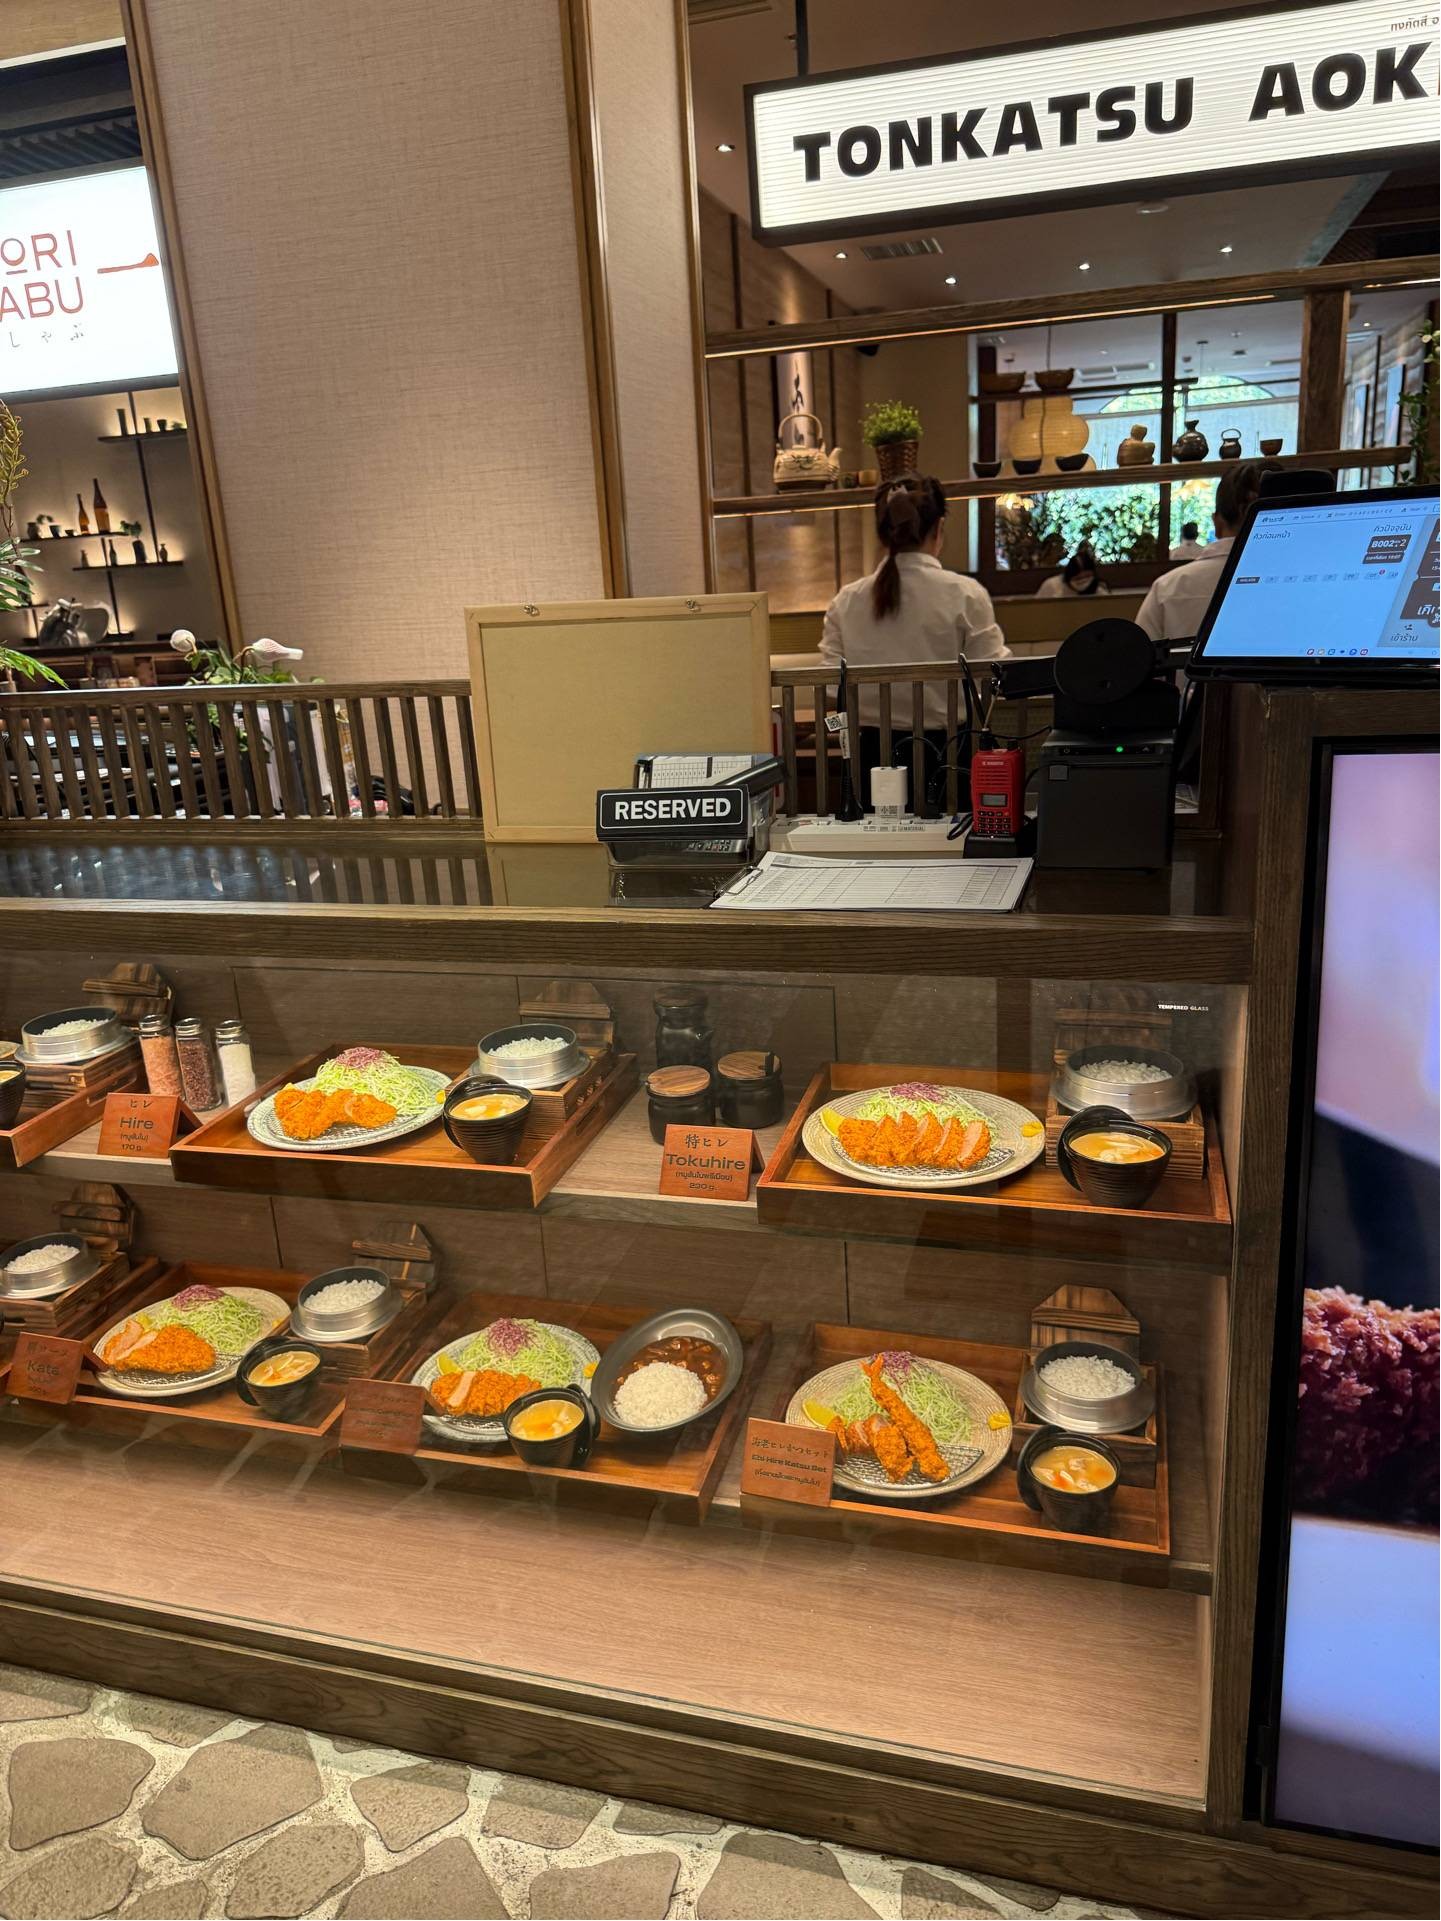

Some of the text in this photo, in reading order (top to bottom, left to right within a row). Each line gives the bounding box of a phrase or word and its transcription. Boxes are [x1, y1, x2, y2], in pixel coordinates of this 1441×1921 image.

[793, 41, 1440, 183] TONKATSU AOK
[615, 798, 731, 820] RESERVED
[119, 1117, 154, 1130] Hire
[685, 1133, 728, 1149] 特ヒレ
[666, 1153, 746, 1171] Tokuhire
